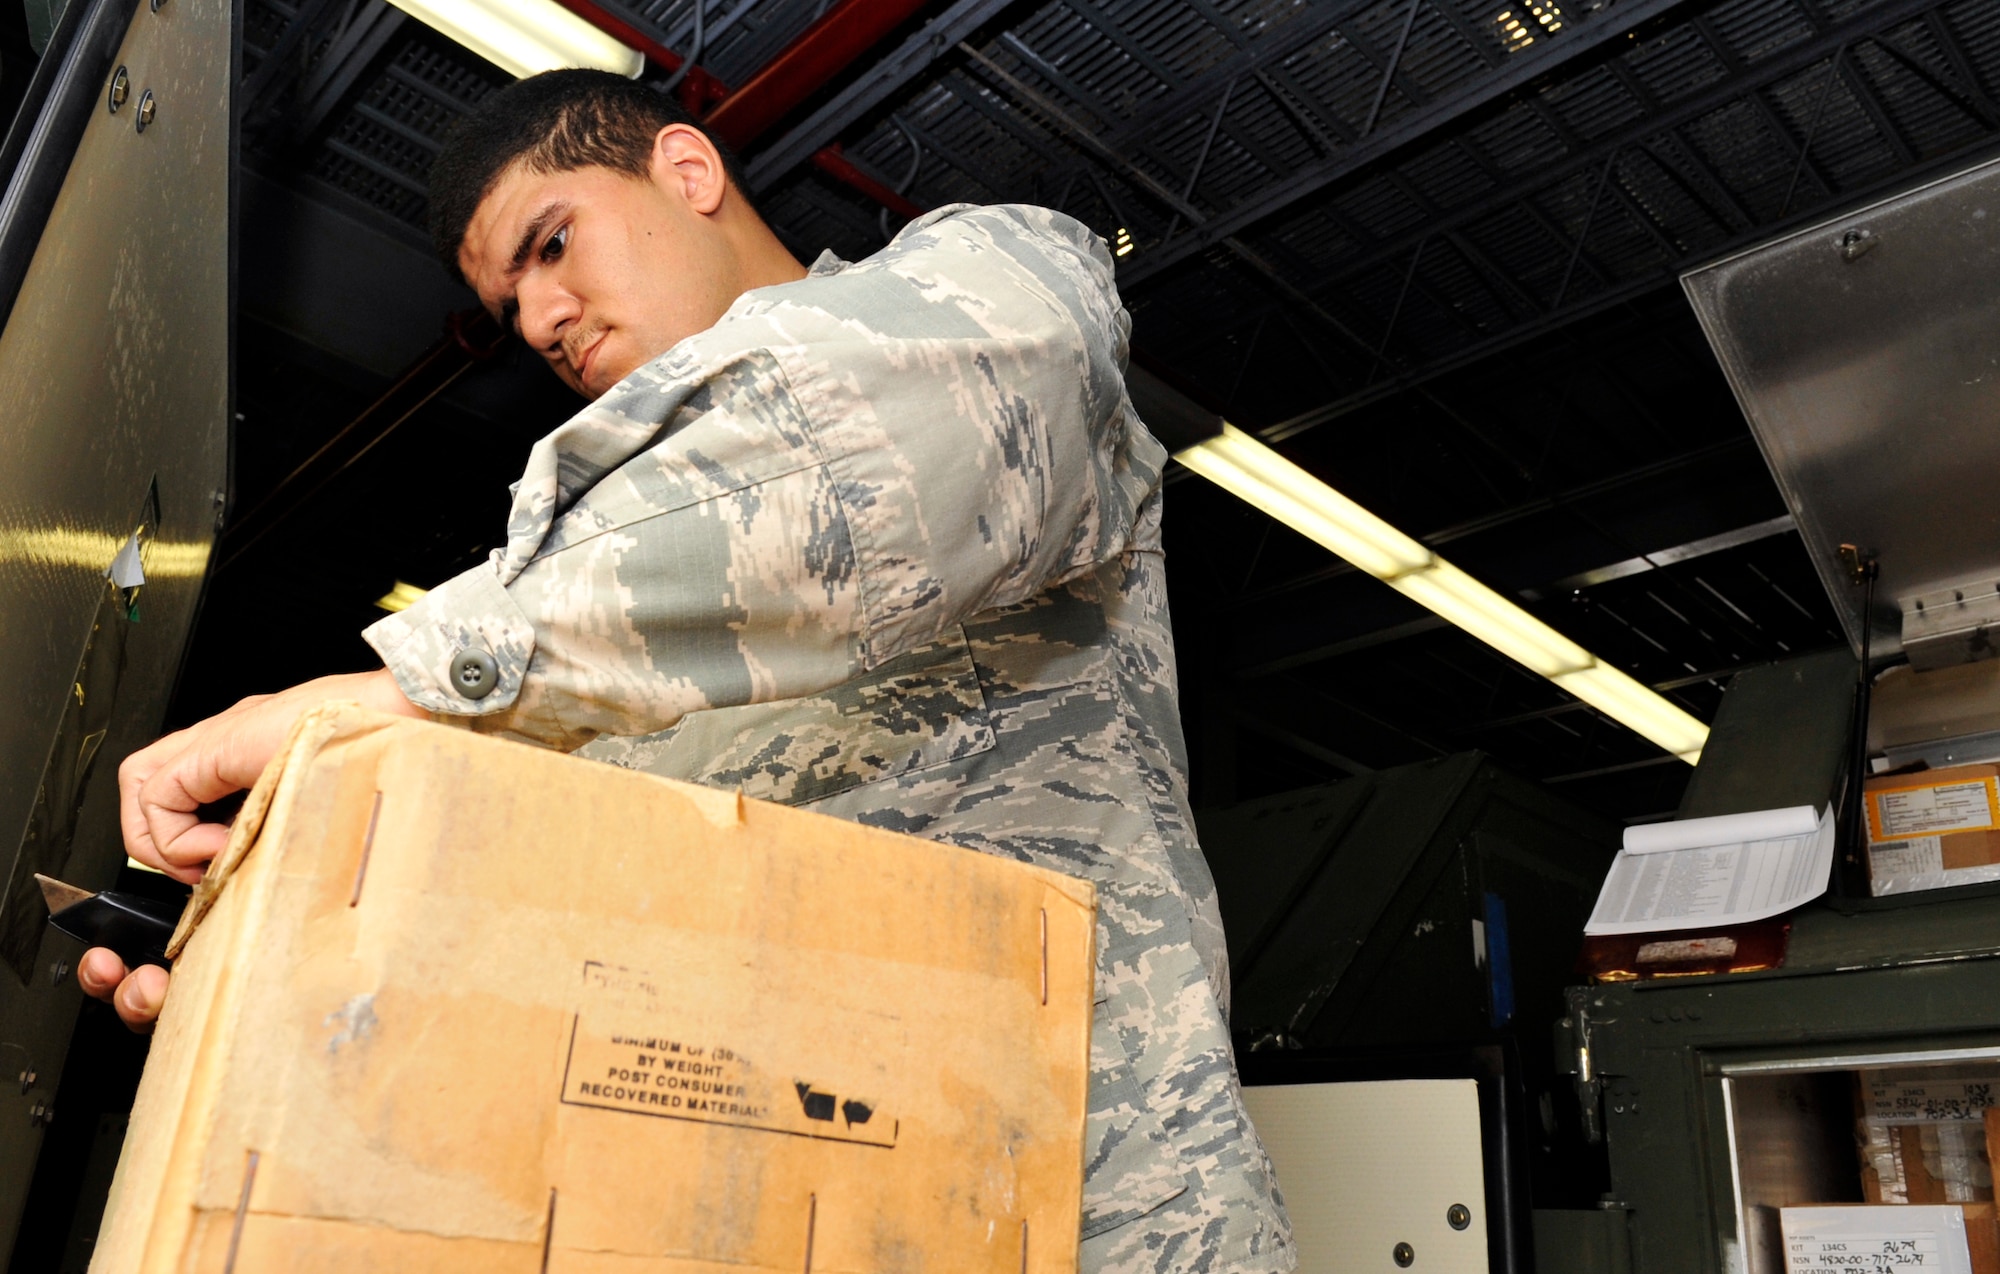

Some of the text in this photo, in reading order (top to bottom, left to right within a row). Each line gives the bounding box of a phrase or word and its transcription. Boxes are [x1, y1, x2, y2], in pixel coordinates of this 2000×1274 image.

[637, 1054, 724, 1078] BY WEIGHT
[608, 1067, 746, 1098] POST CONSUMER
[580, 1081, 682, 1108] RECOVERED
[1877, 1110, 1918, 1119] LOCATION
[1791, 1243, 1804, 1251] KIT
[1822, 1243, 1848, 1251] 134CS
[1792, 1256, 1810, 1264] NSN
